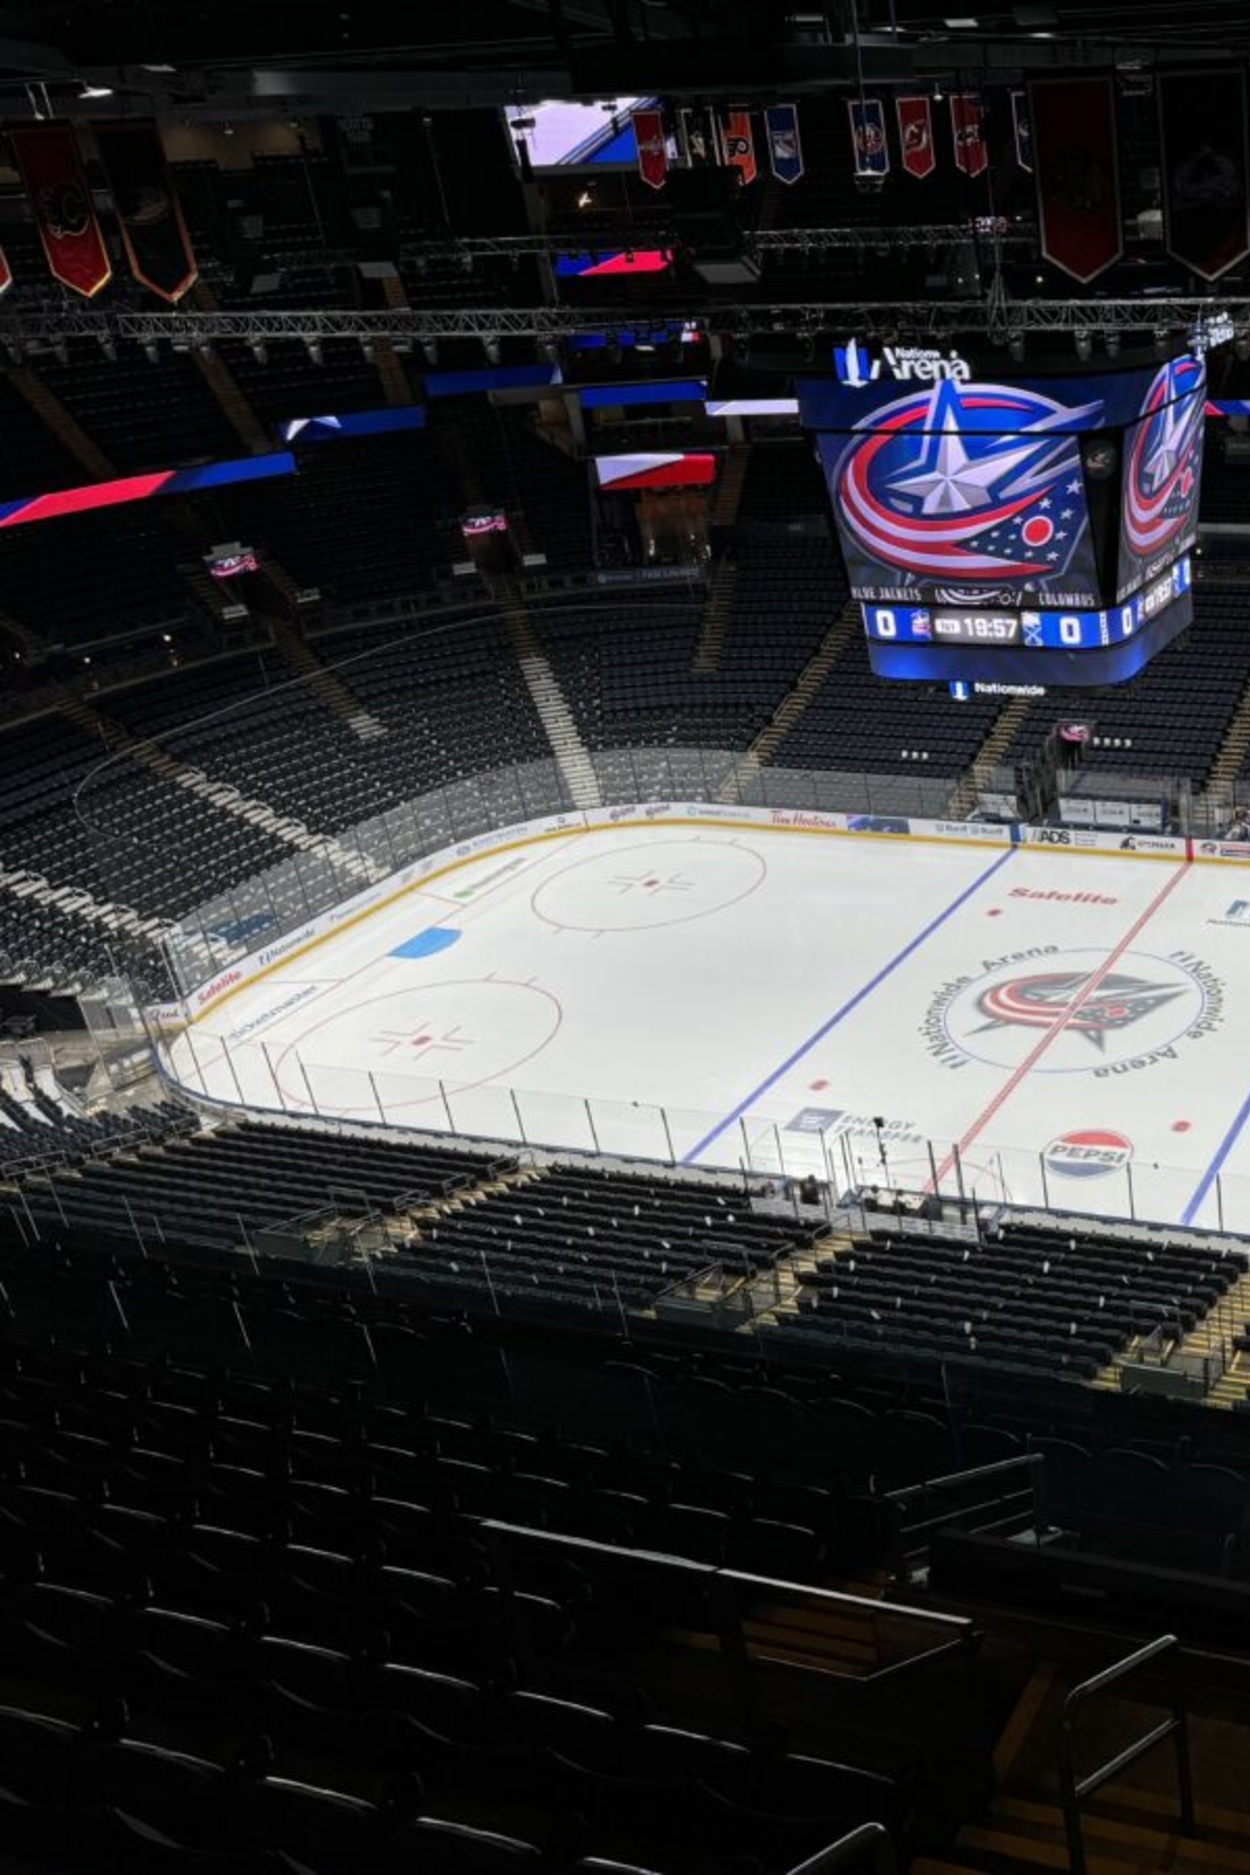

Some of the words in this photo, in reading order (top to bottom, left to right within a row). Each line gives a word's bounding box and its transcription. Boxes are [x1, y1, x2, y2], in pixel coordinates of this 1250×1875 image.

[878, 588, 922, 601] JACKETS
[1039, 593, 1095, 607] COLUMBUS
[875, 610, 897, 637] 0
[964, 618, 1018, 638] 19:57
[1059, 617, 1082, 644] 0
[974, 682, 1045, 697] Nationwide
[769, 809, 791, 824] Tim
[793, 811, 836, 828] Hortons
[1039, 830, 1070, 845] ADS
[1008, 887, 1118, 905] Safelite
[917, 976, 970, 1058] Nationwide
[982, 945, 1059, 972] Arena
[1182, 959, 1227, 1040] Nationwide
[1092, 1045, 1178, 1078] Arena
[842, 1115, 917, 1130] ENEGY
[1049, 1144, 1127, 1164] PEPSI
